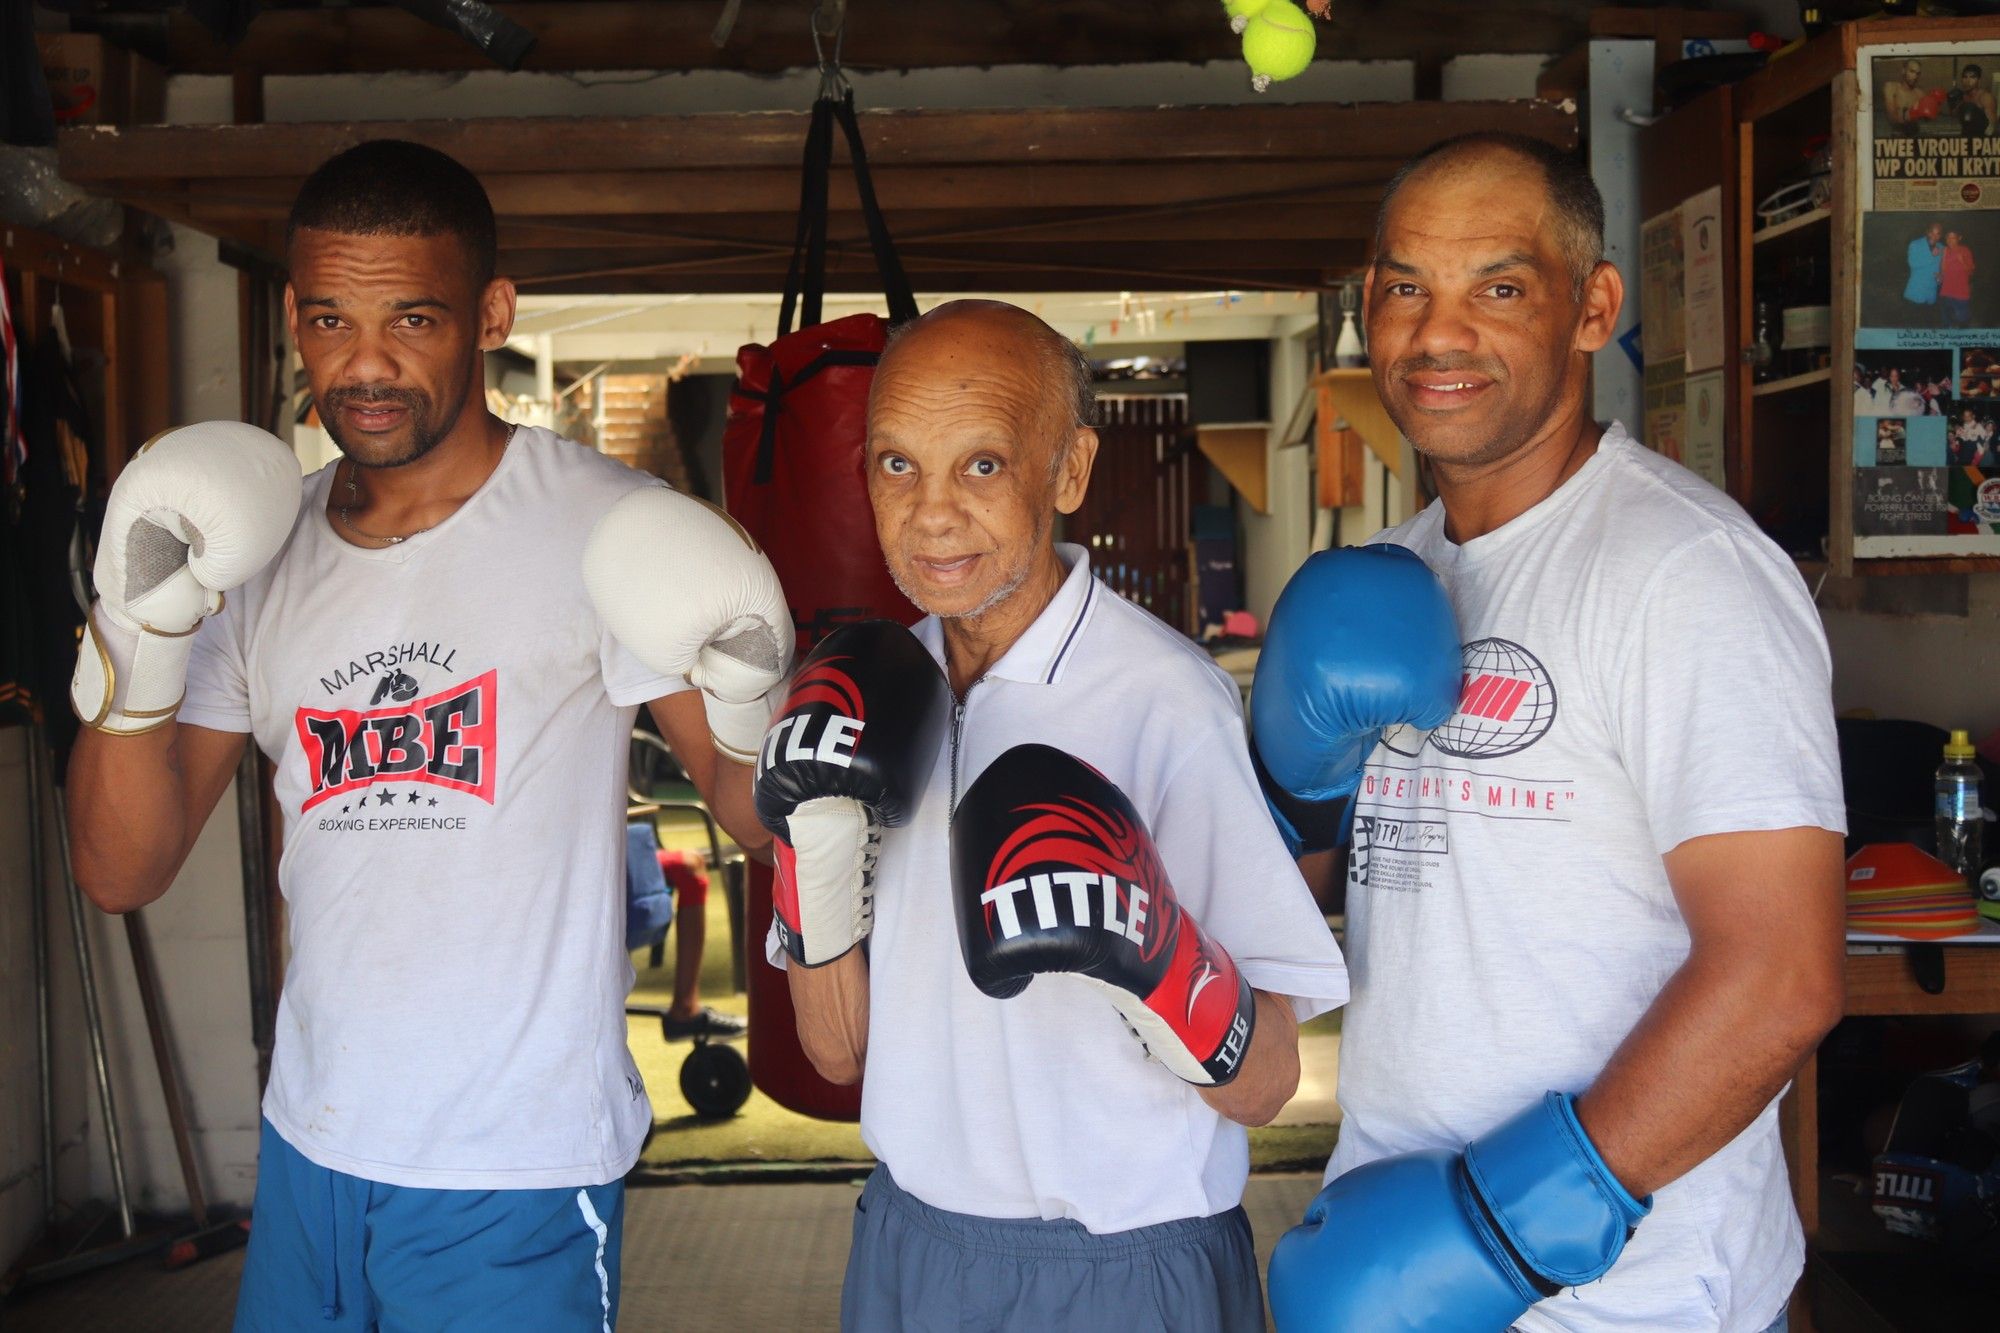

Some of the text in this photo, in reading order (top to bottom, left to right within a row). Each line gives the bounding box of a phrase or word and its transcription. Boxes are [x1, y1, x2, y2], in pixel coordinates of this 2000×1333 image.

[1874, 138, 1914, 157] TWEE
[1917, 137, 1968, 156] VROUE
[1875, 158, 1901, 177] WP
[1904, 158, 1938, 177] OOK
[1941, 158, 1958, 176] IN
[1864, 503, 1910, 512] POWERFUL
[1879, 512, 1932, 521] FIGHT STRESS
[319, 641, 457, 695] MARSHALL
[305, 687, 482, 793] MBE
[318, 817, 467, 832] BOXING EXPERIENCE
[980, 871, 1150, 947] TITLE
[1875, 1172, 1933, 1203] TITLE
